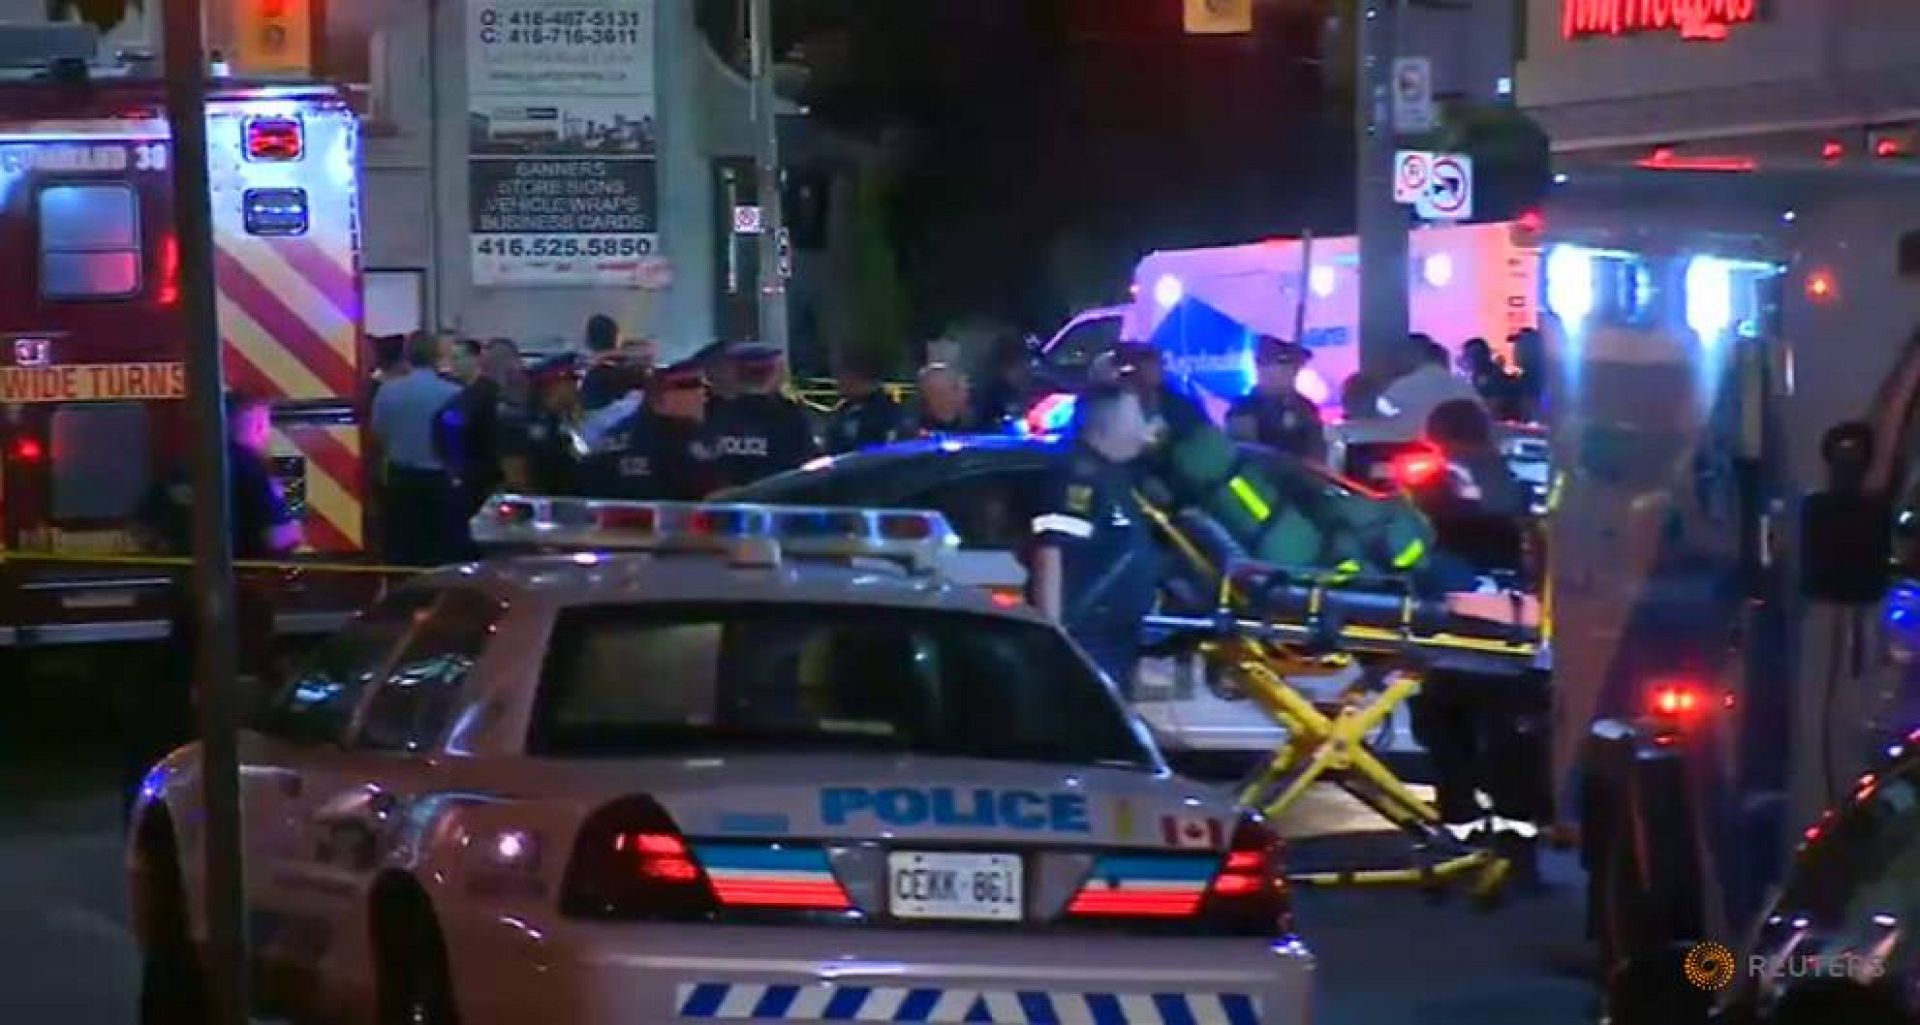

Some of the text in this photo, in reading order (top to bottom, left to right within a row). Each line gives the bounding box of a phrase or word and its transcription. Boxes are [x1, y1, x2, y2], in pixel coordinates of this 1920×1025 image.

[480, 28, 503, 43] C:
[515, 162, 606, 177] BANNERS
[496, 179, 626, 195] STORE SIGNS
[571, 197, 640, 212] WRAPS
[480, 214, 646, 230] BUSINESS CARDS
[477, 238, 651, 257] 416.525.5850
[5, 366, 185, 399] WIDE TURNS
[820, 787, 1091, 832] POLICE
